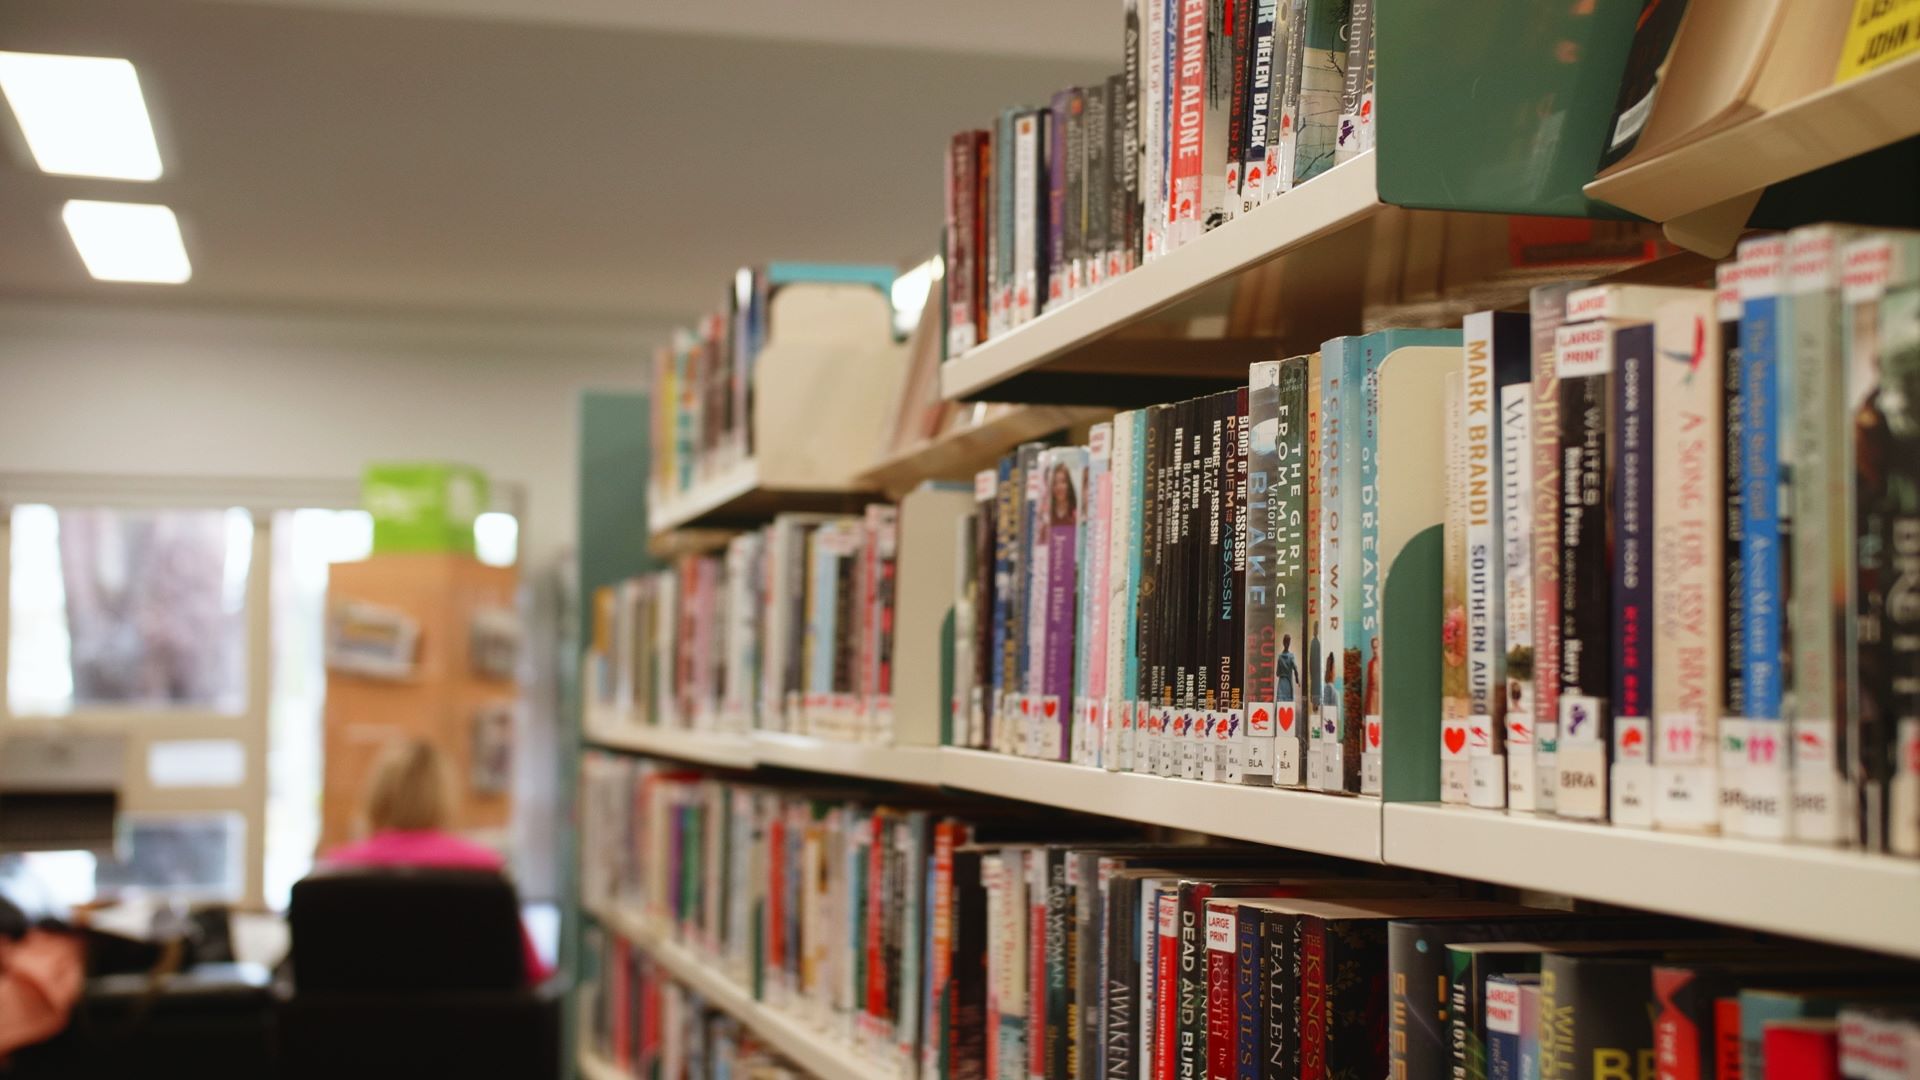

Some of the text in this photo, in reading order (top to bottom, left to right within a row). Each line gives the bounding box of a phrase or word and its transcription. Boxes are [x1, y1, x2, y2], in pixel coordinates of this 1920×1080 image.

[1348, 3, 1368, 57] Blunt
[1179, 86, 1201, 159] ALONE
[1251, 36, 1272, 148] HELEN BLACK
[1559, 329, 1604, 348] LARGE
[1567, 295, 1605, 314] LARGE
[1562, 349, 1601, 364] PRINT
[1467, 339, 1489, 527] MARK BRANDI
[1533, 376, 1560, 445] Spy
[1157, 468, 1165, 501] BLACK
[1166, 467, 1174, 499] BLACK
[1171, 427, 1183, 544] RETURN ASSASSIN
[1191, 435, 1201, 509] KING OF SWORDS
[1203, 457, 1213, 494] BLACK
[1210, 420, 1222, 545] REVENGE ASSASSIN
[1224, 415, 1236, 508] REQUIEM
[1564, 447, 1583, 506] Richard
[1583, 407, 1600, 506] WHITES
[1623, 357, 1639, 590] DOWN THE DARKEST ROAD
[1144, 427, 1156, 557] OLIVIE BLAKE
[1181, 462, 1191, 537] BLACK IS BACK
[1234, 416, 1249, 571] BLOOD OF THE ASSASSIN
[1267, 483, 1278, 540] Victoria
[1276, 404, 1289, 618] FROM MUNICH
[1289, 442, 1302, 577] THE GIRL
[1329, 378, 1340, 632] ECHOES OF WAR
[1678, 411, 1706, 636] A SONG FOR ISSY
[1052, 533, 1066, 581] Jessica
[1247, 471, 1267, 605] BLAKE
[1362, 446, 1375, 632] OF DREAMS
[1563, 507, 1582, 547] Price
[1221, 523, 1234, 620] ASSASSIN
[1308, 509, 1316, 615] BERLIN
[1051, 587, 1066, 623] Blair
[1470, 545, 1487, 653] SOUTHERN
[1562, 638, 1583, 683] Harry
[1623, 605, 1638, 669] KYLIE
[1176, 667, 1185, 696] RUSSELL
[1198, 666, 1207, 696] RUSSELL
[1249, 759, 1263, 768] BLA
[1561, 770, 1597, 789] BRA
[1050, 865, 1066, 989] DEAD WOMAN
[1182, 911, 1196, 972] DEAD
[1208, 916, 1230, 929] LARGE
[1208, 930, 1229, 943] PRINT
[1240, 922, 1254, 934] THE
[1271, 923, 1284, 934] THE
[1306, 934, 1321, 948] THE
[1067, 1003, 1079, 1040] NOW
[1158, 956, 1168, 1068] THE PHILOSOPHER'S
[1181, 978, 1195, 1025] AND
[1211, 953, 1228, 1069] BOOTH the
[1240, 939, 1253, 1065] DEVIL'S
[1270, 939, 1283, 1069] FALLEN
[1306, 951, 1320, 1068] KING'S
[1452, 984, 1467, 1059] THE LOST
[1485, 1006, 1514, 1023] PRINT
[1486, 989, 1519, 1006] LARGE
